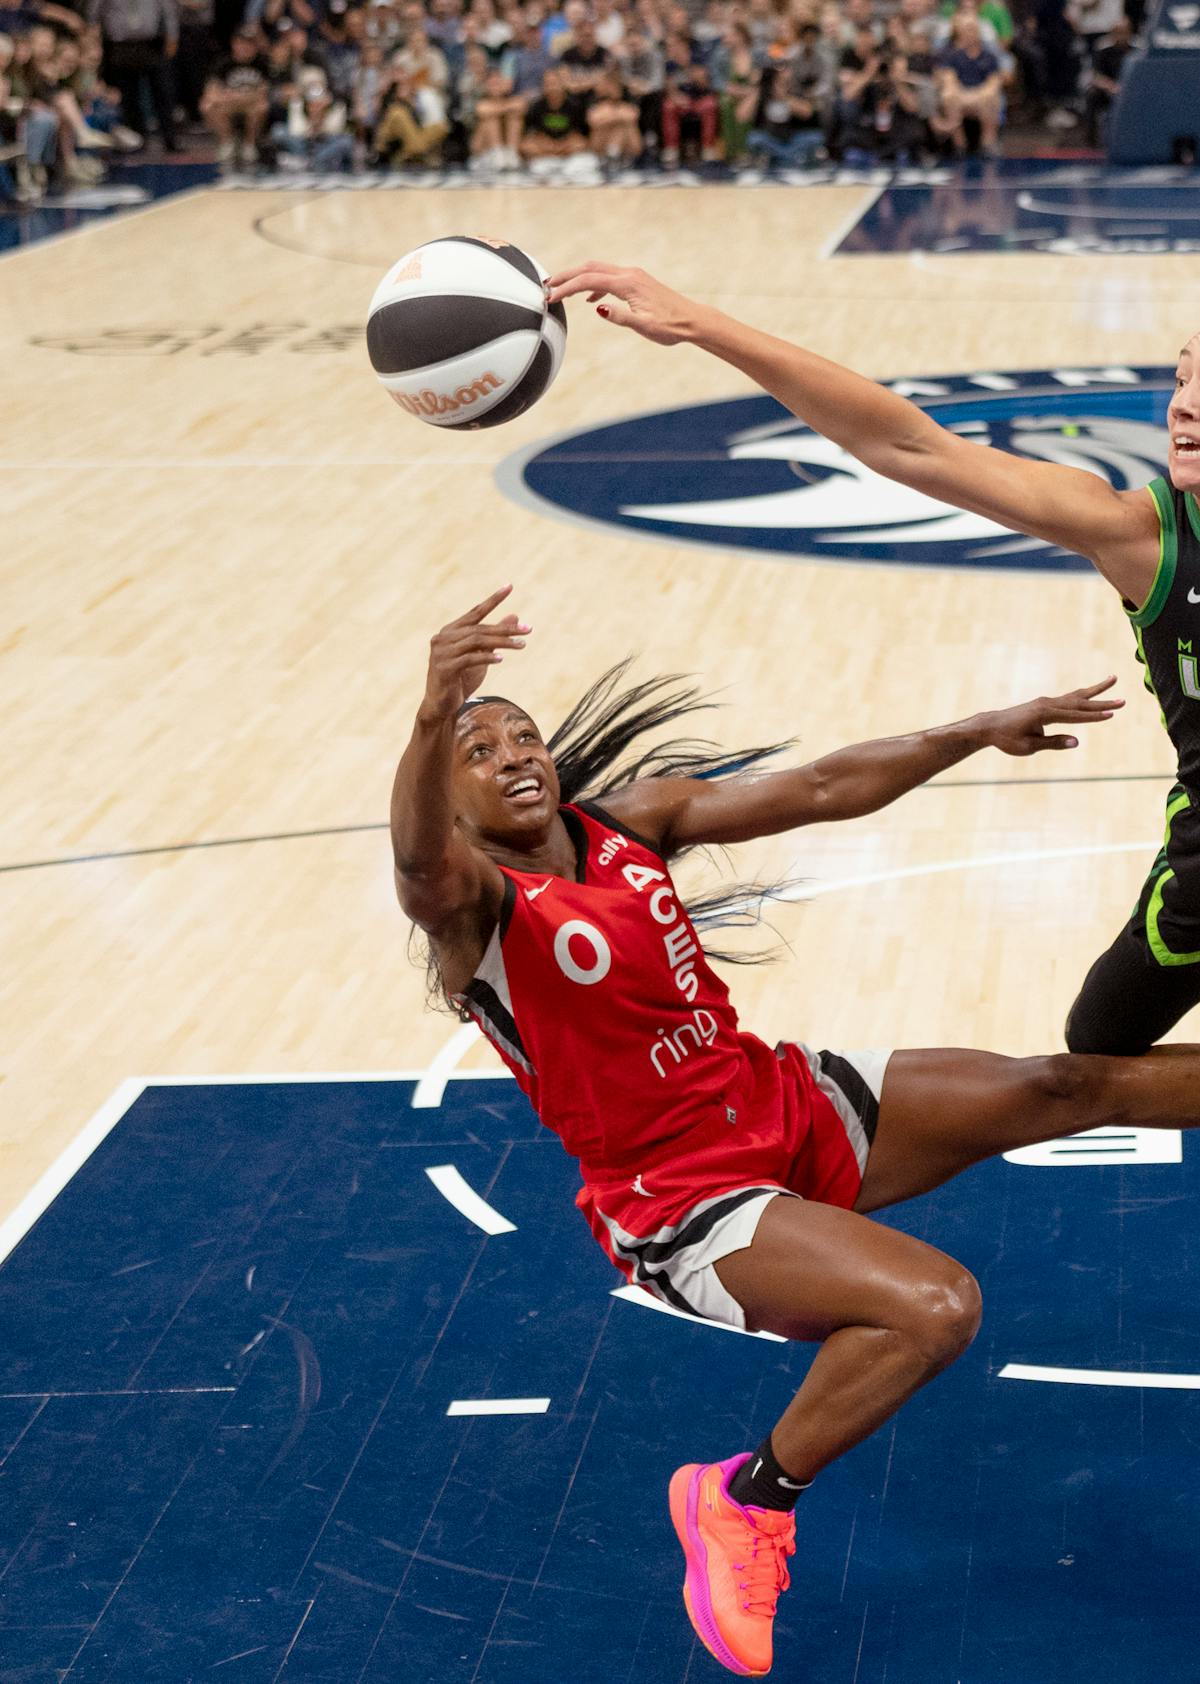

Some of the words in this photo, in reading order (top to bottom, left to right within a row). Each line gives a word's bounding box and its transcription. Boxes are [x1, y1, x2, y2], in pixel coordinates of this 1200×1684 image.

[387, 371, 504, 415] Wilson
[597, 833, 630, 867] ally
[554, 919, 612, 985] 0
[622, 863, 700, 1002] ACES
[650, 1009, 719, 1078] ring
